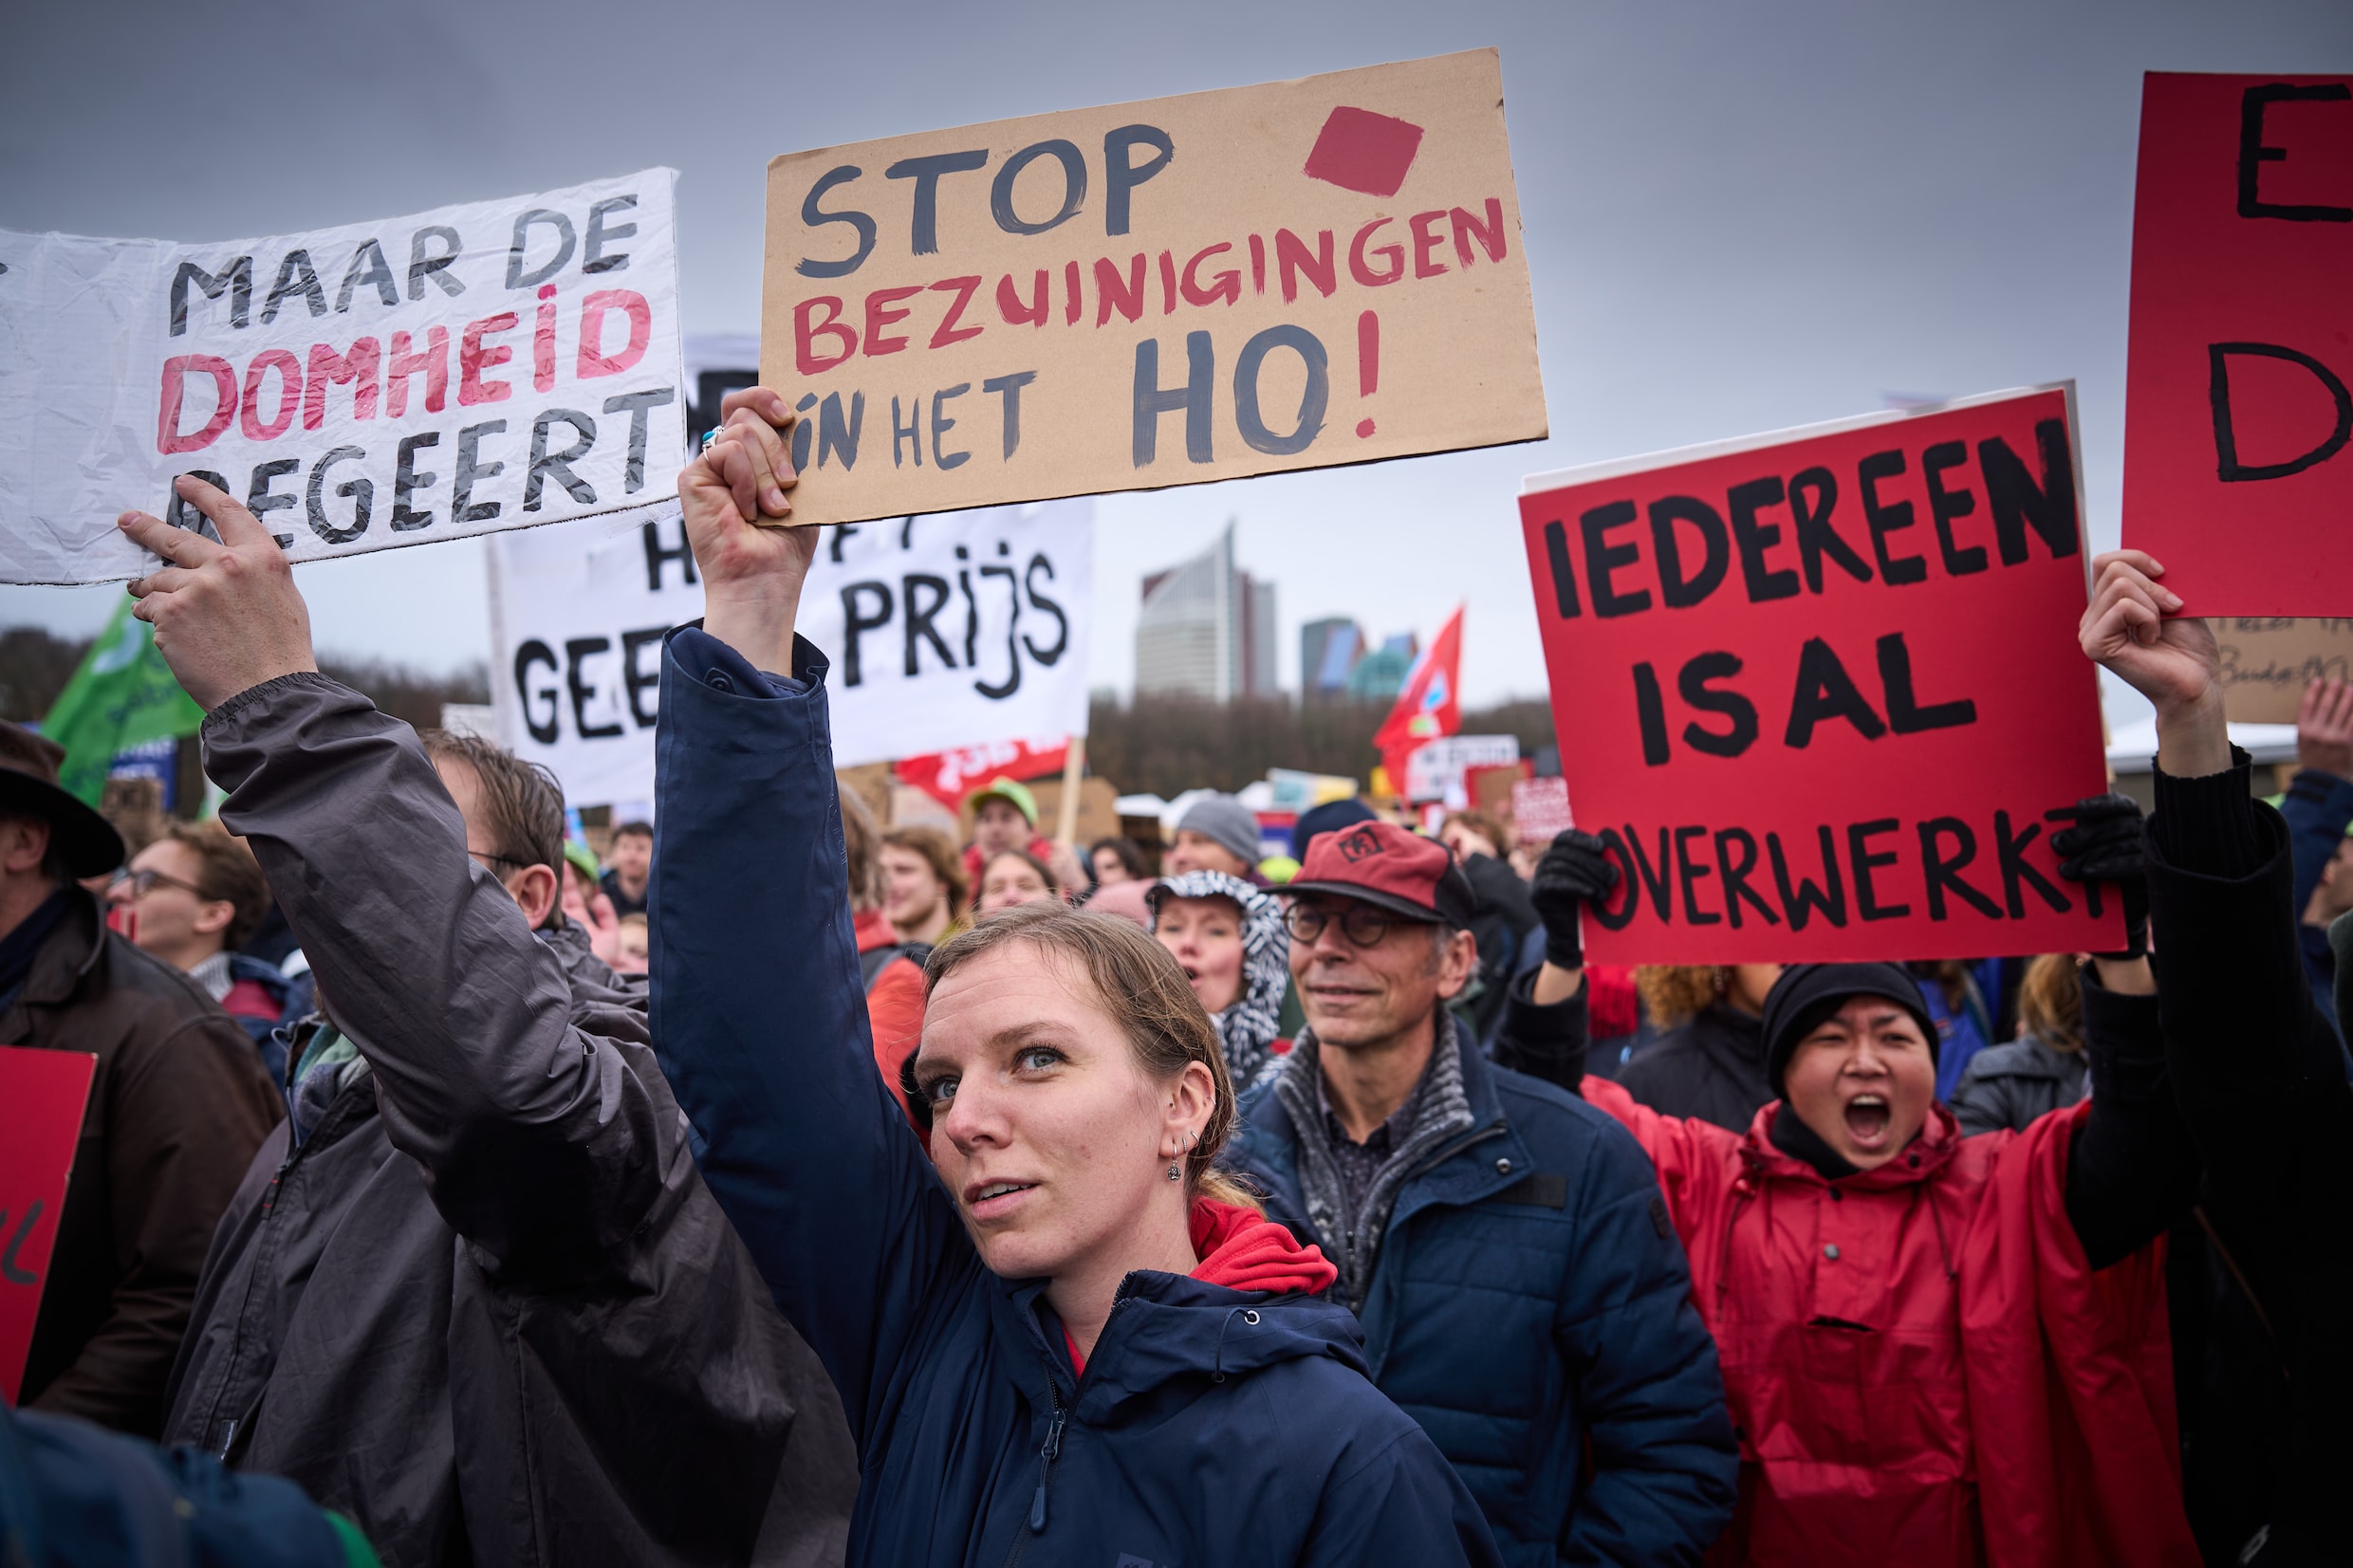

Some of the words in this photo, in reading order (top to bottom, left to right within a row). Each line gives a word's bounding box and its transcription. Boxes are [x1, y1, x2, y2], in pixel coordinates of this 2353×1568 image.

[169, 226, 467, 338] MAAR
[505, 194, 639, 289] DE
[794, 123, 1176, 279] STOP
[793, 196, 1508, 377] BEZUINIGINGEN
[893, 370, 1038, 471] HET
[1133, 309, 1380, 470] HO!
[1544, 417, 2078, 619] IEDEREEN
[513, 626, 672, 746] GEE
[1631, 651, 1759, 766] IS
[1784, 631, 1977, 749] AL
